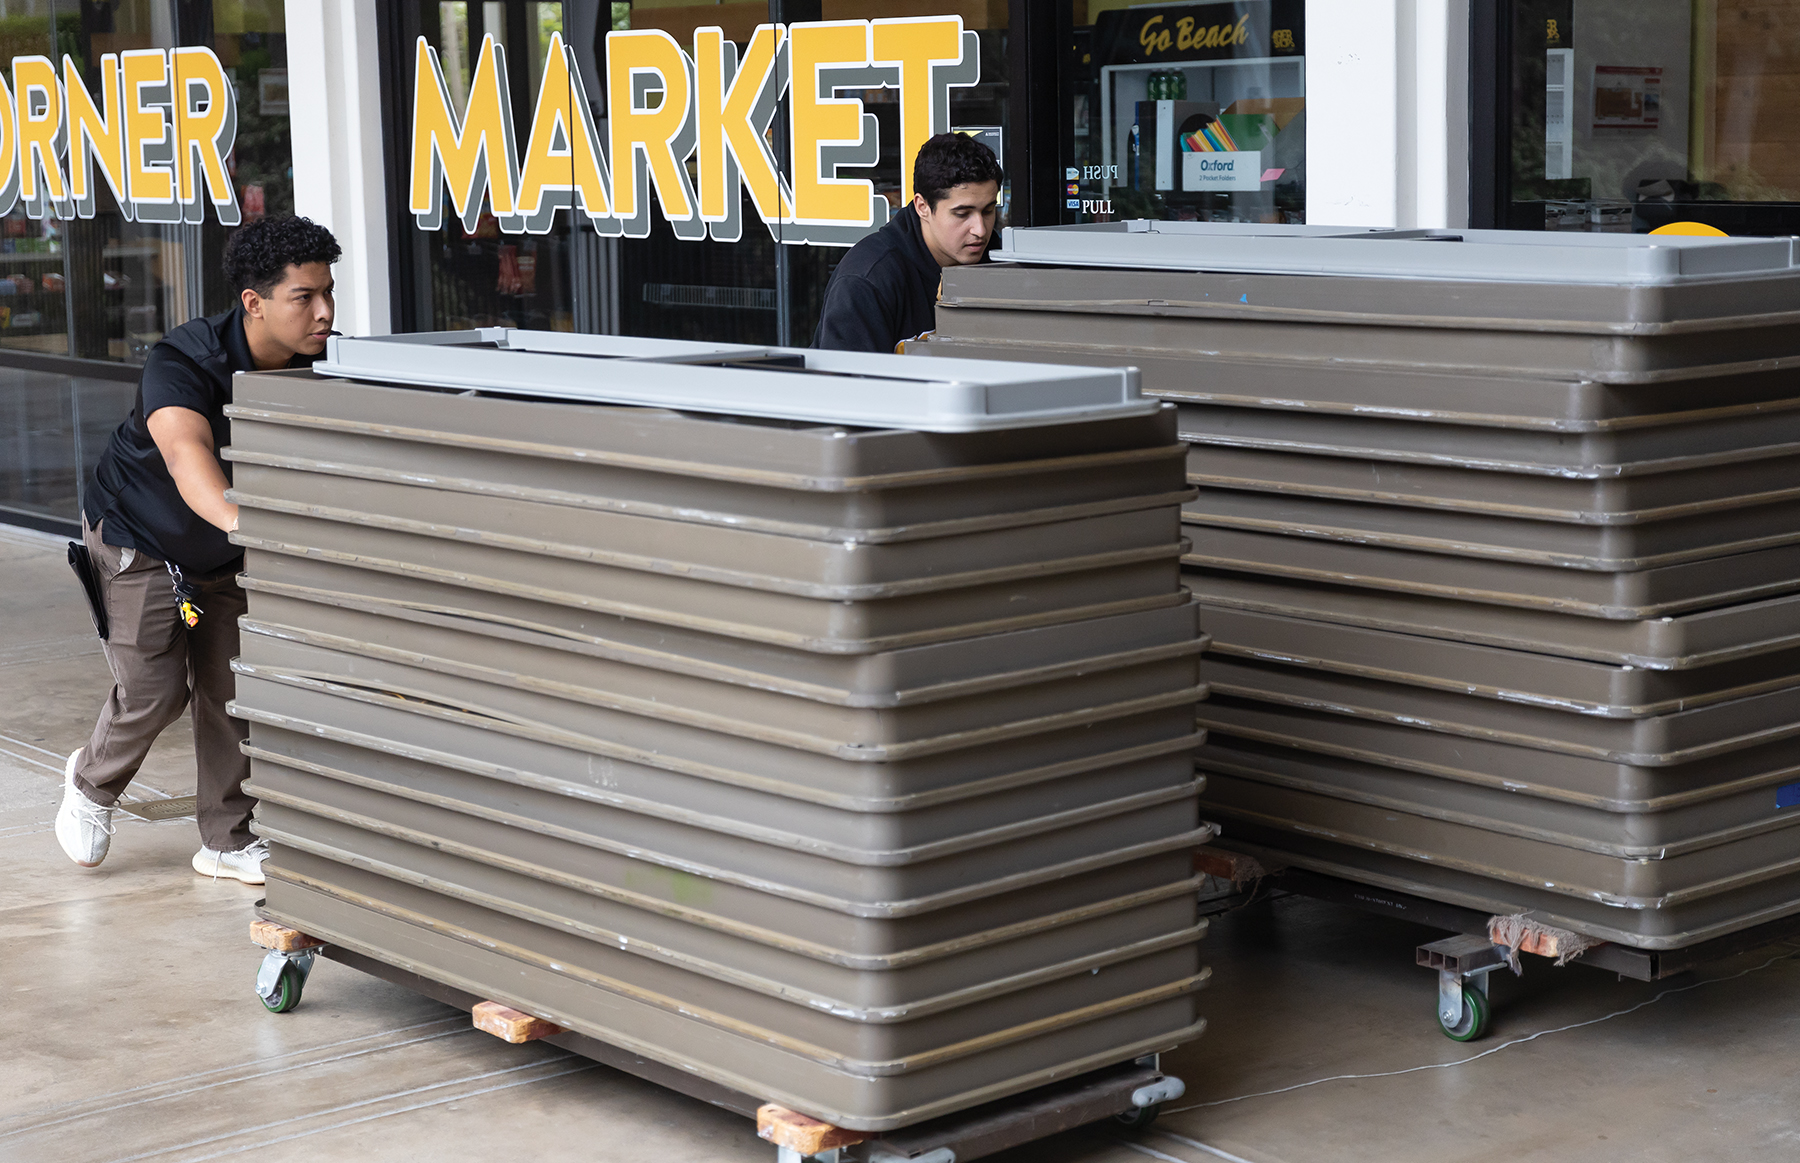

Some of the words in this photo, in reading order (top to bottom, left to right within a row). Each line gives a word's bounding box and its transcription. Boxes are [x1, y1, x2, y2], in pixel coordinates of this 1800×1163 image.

[1139, 15, 1174, 56] Go
[1176, 13, 1249, 51] Beach
[410, 15, 980, 247] MARKET
[1200, 159, 1234, 171] Oxford
[1082, 199, 1115, 214] PULL
